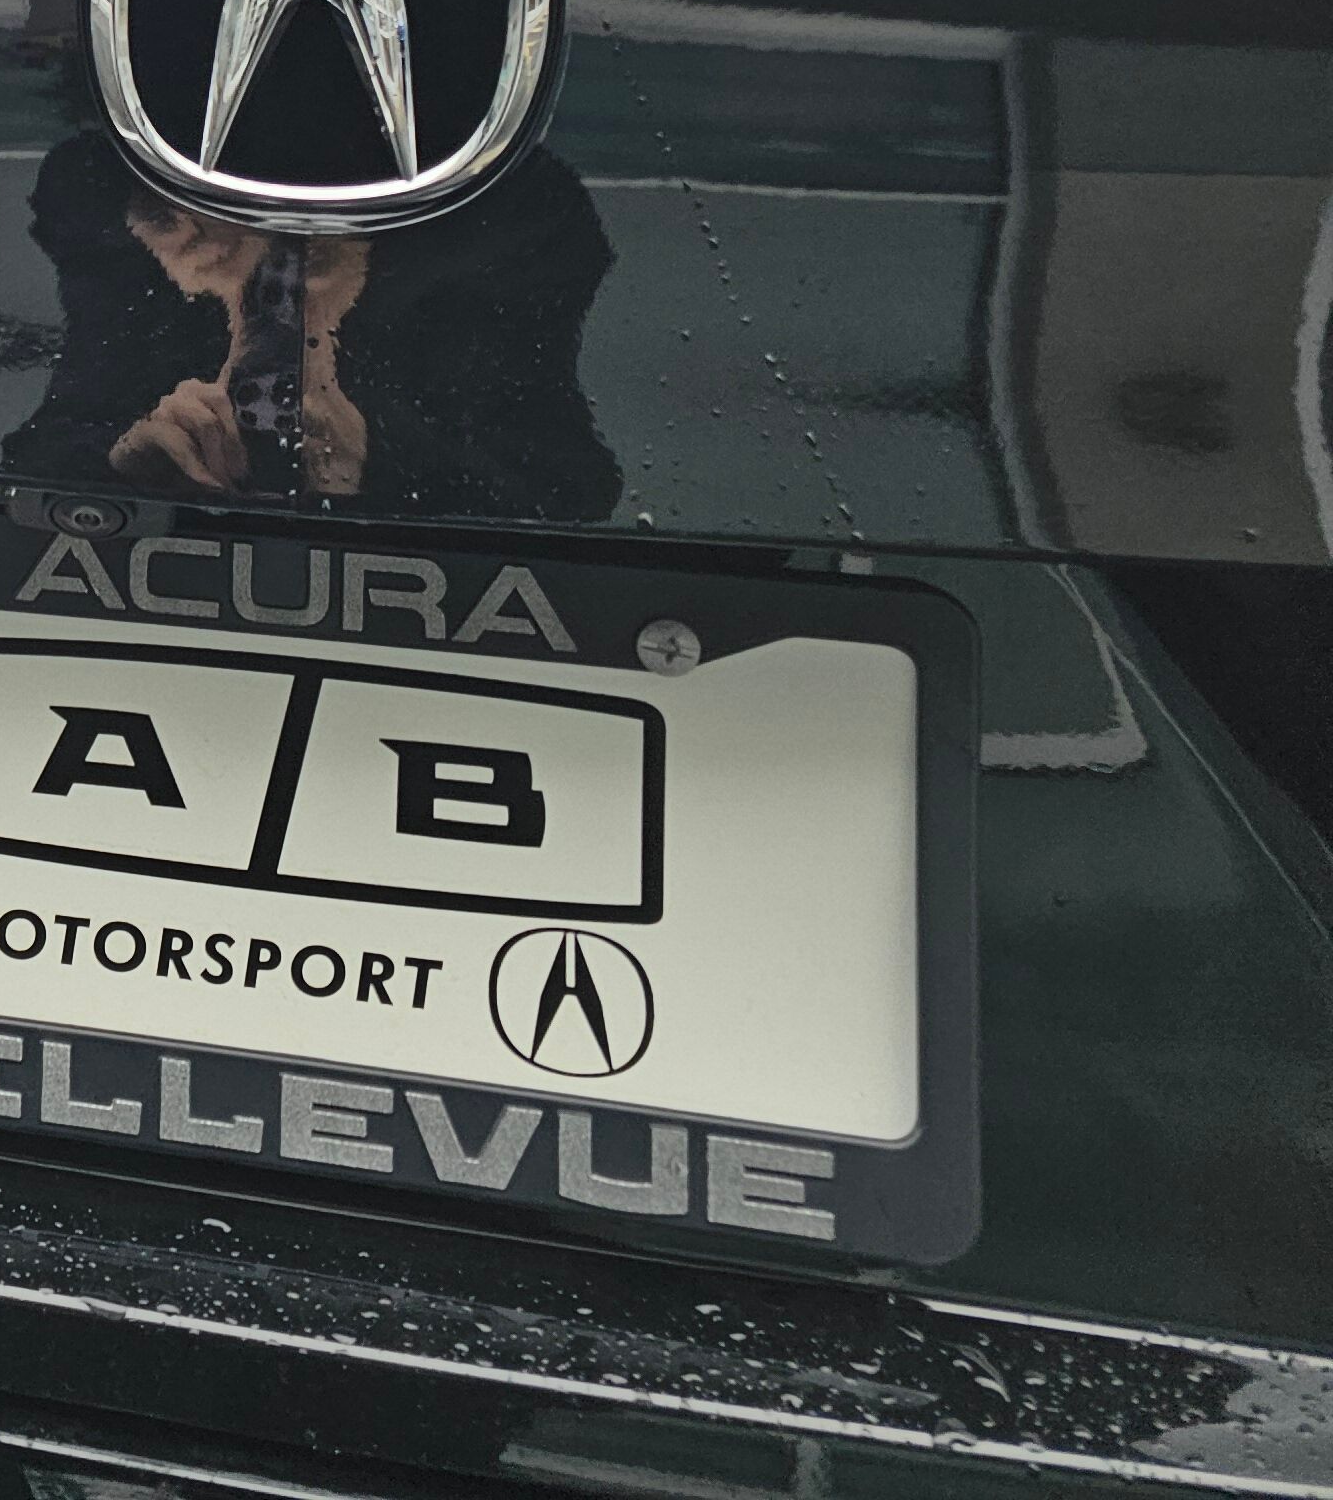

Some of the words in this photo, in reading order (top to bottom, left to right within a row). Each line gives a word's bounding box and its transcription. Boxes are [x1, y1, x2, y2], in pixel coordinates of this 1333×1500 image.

[16, 538, 577, 654] ACURA
[33, 705, 187, 809] A
[380, 738, 545, 847] B
